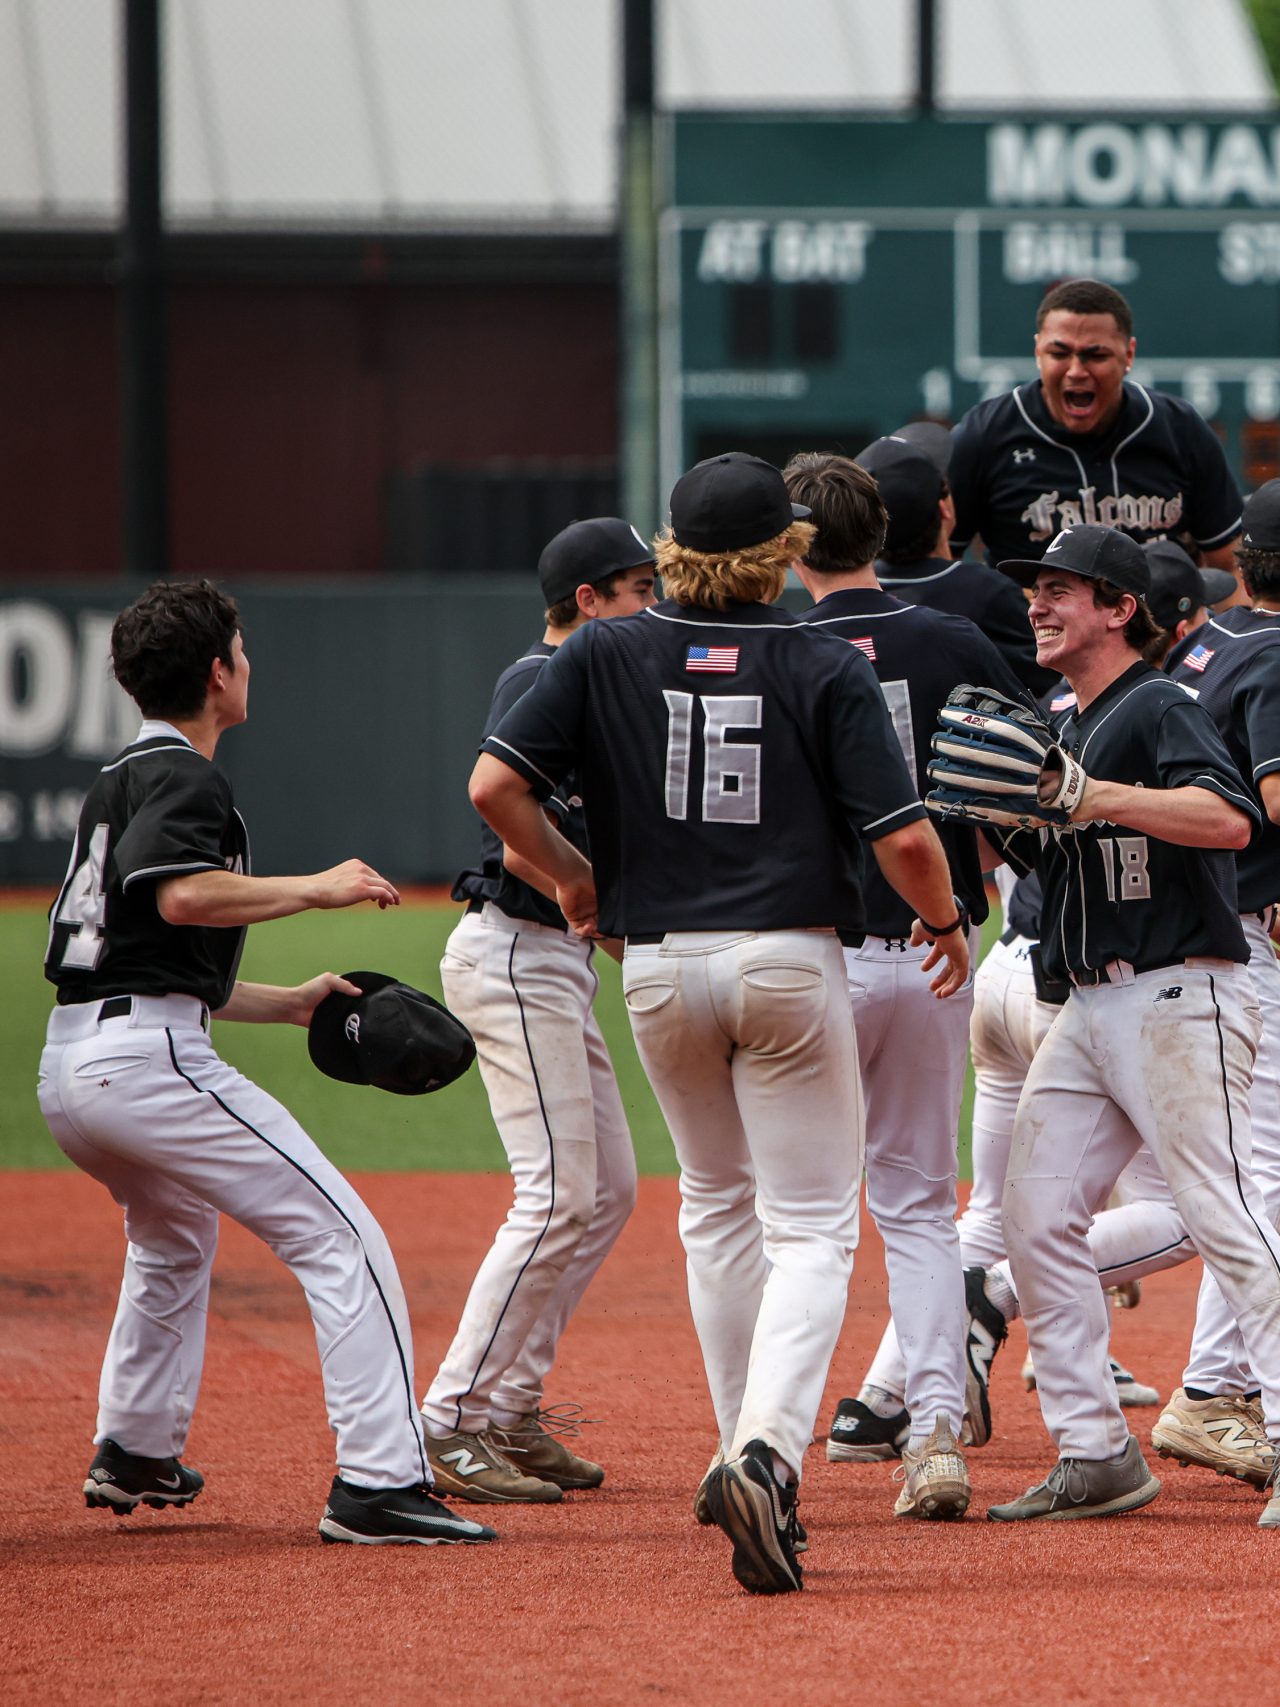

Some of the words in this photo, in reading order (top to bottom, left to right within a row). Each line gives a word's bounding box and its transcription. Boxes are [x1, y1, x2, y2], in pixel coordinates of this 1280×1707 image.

[699, 220, 767, 284] AT
[770, 220, 873, 284] BAT
[1003, 221, 1139, 284] BALL
[1021, 487, 1183, 542] Falcons
[662, 690, 763, 824] 16
[1097, 836, 1151, 902] 18
